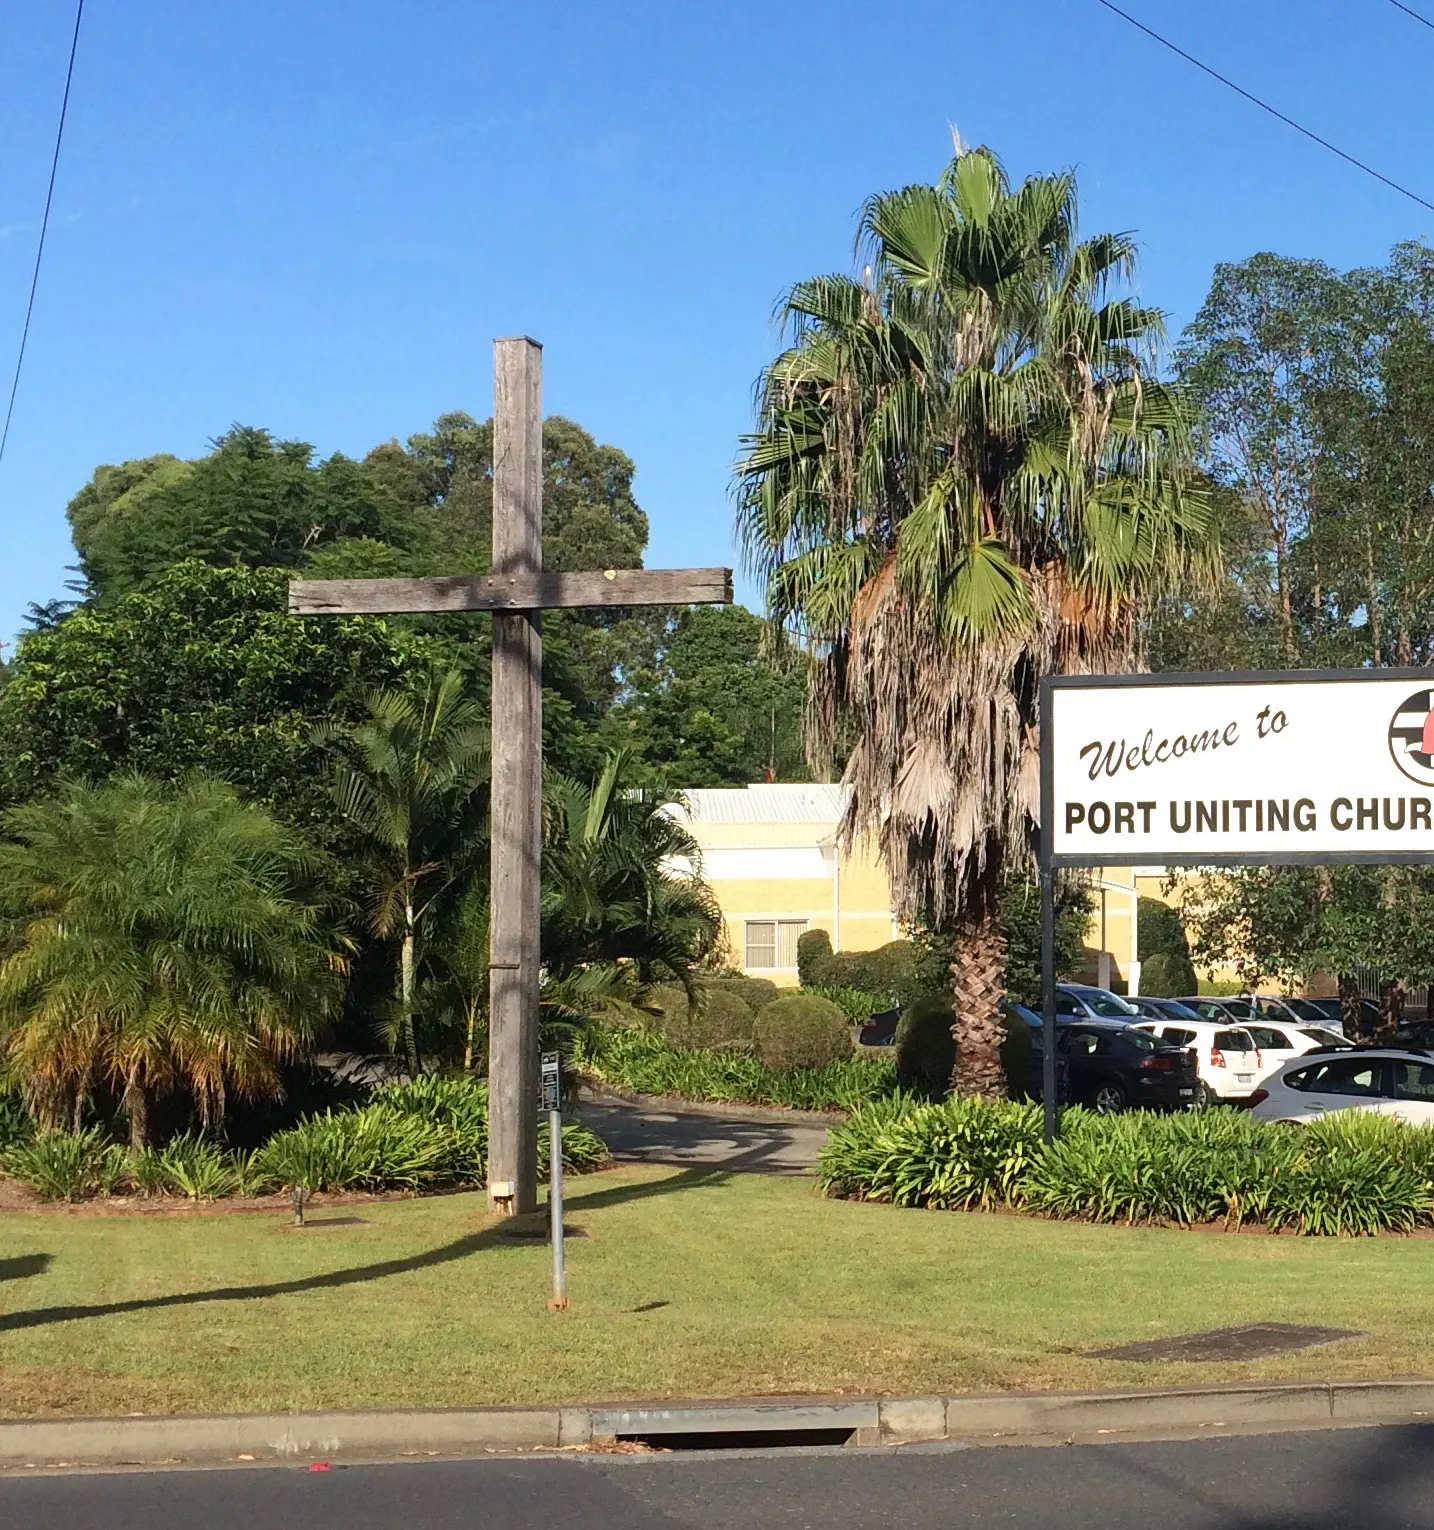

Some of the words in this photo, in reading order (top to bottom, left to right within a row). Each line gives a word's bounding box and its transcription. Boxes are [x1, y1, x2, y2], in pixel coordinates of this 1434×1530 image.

[1080, 722, 1238, 780] Welcome
[1257, 705, 1288, 738] to
[1066, 802, 1156, 834] PORT
[1170, 798, 1316, 833] UNITING
